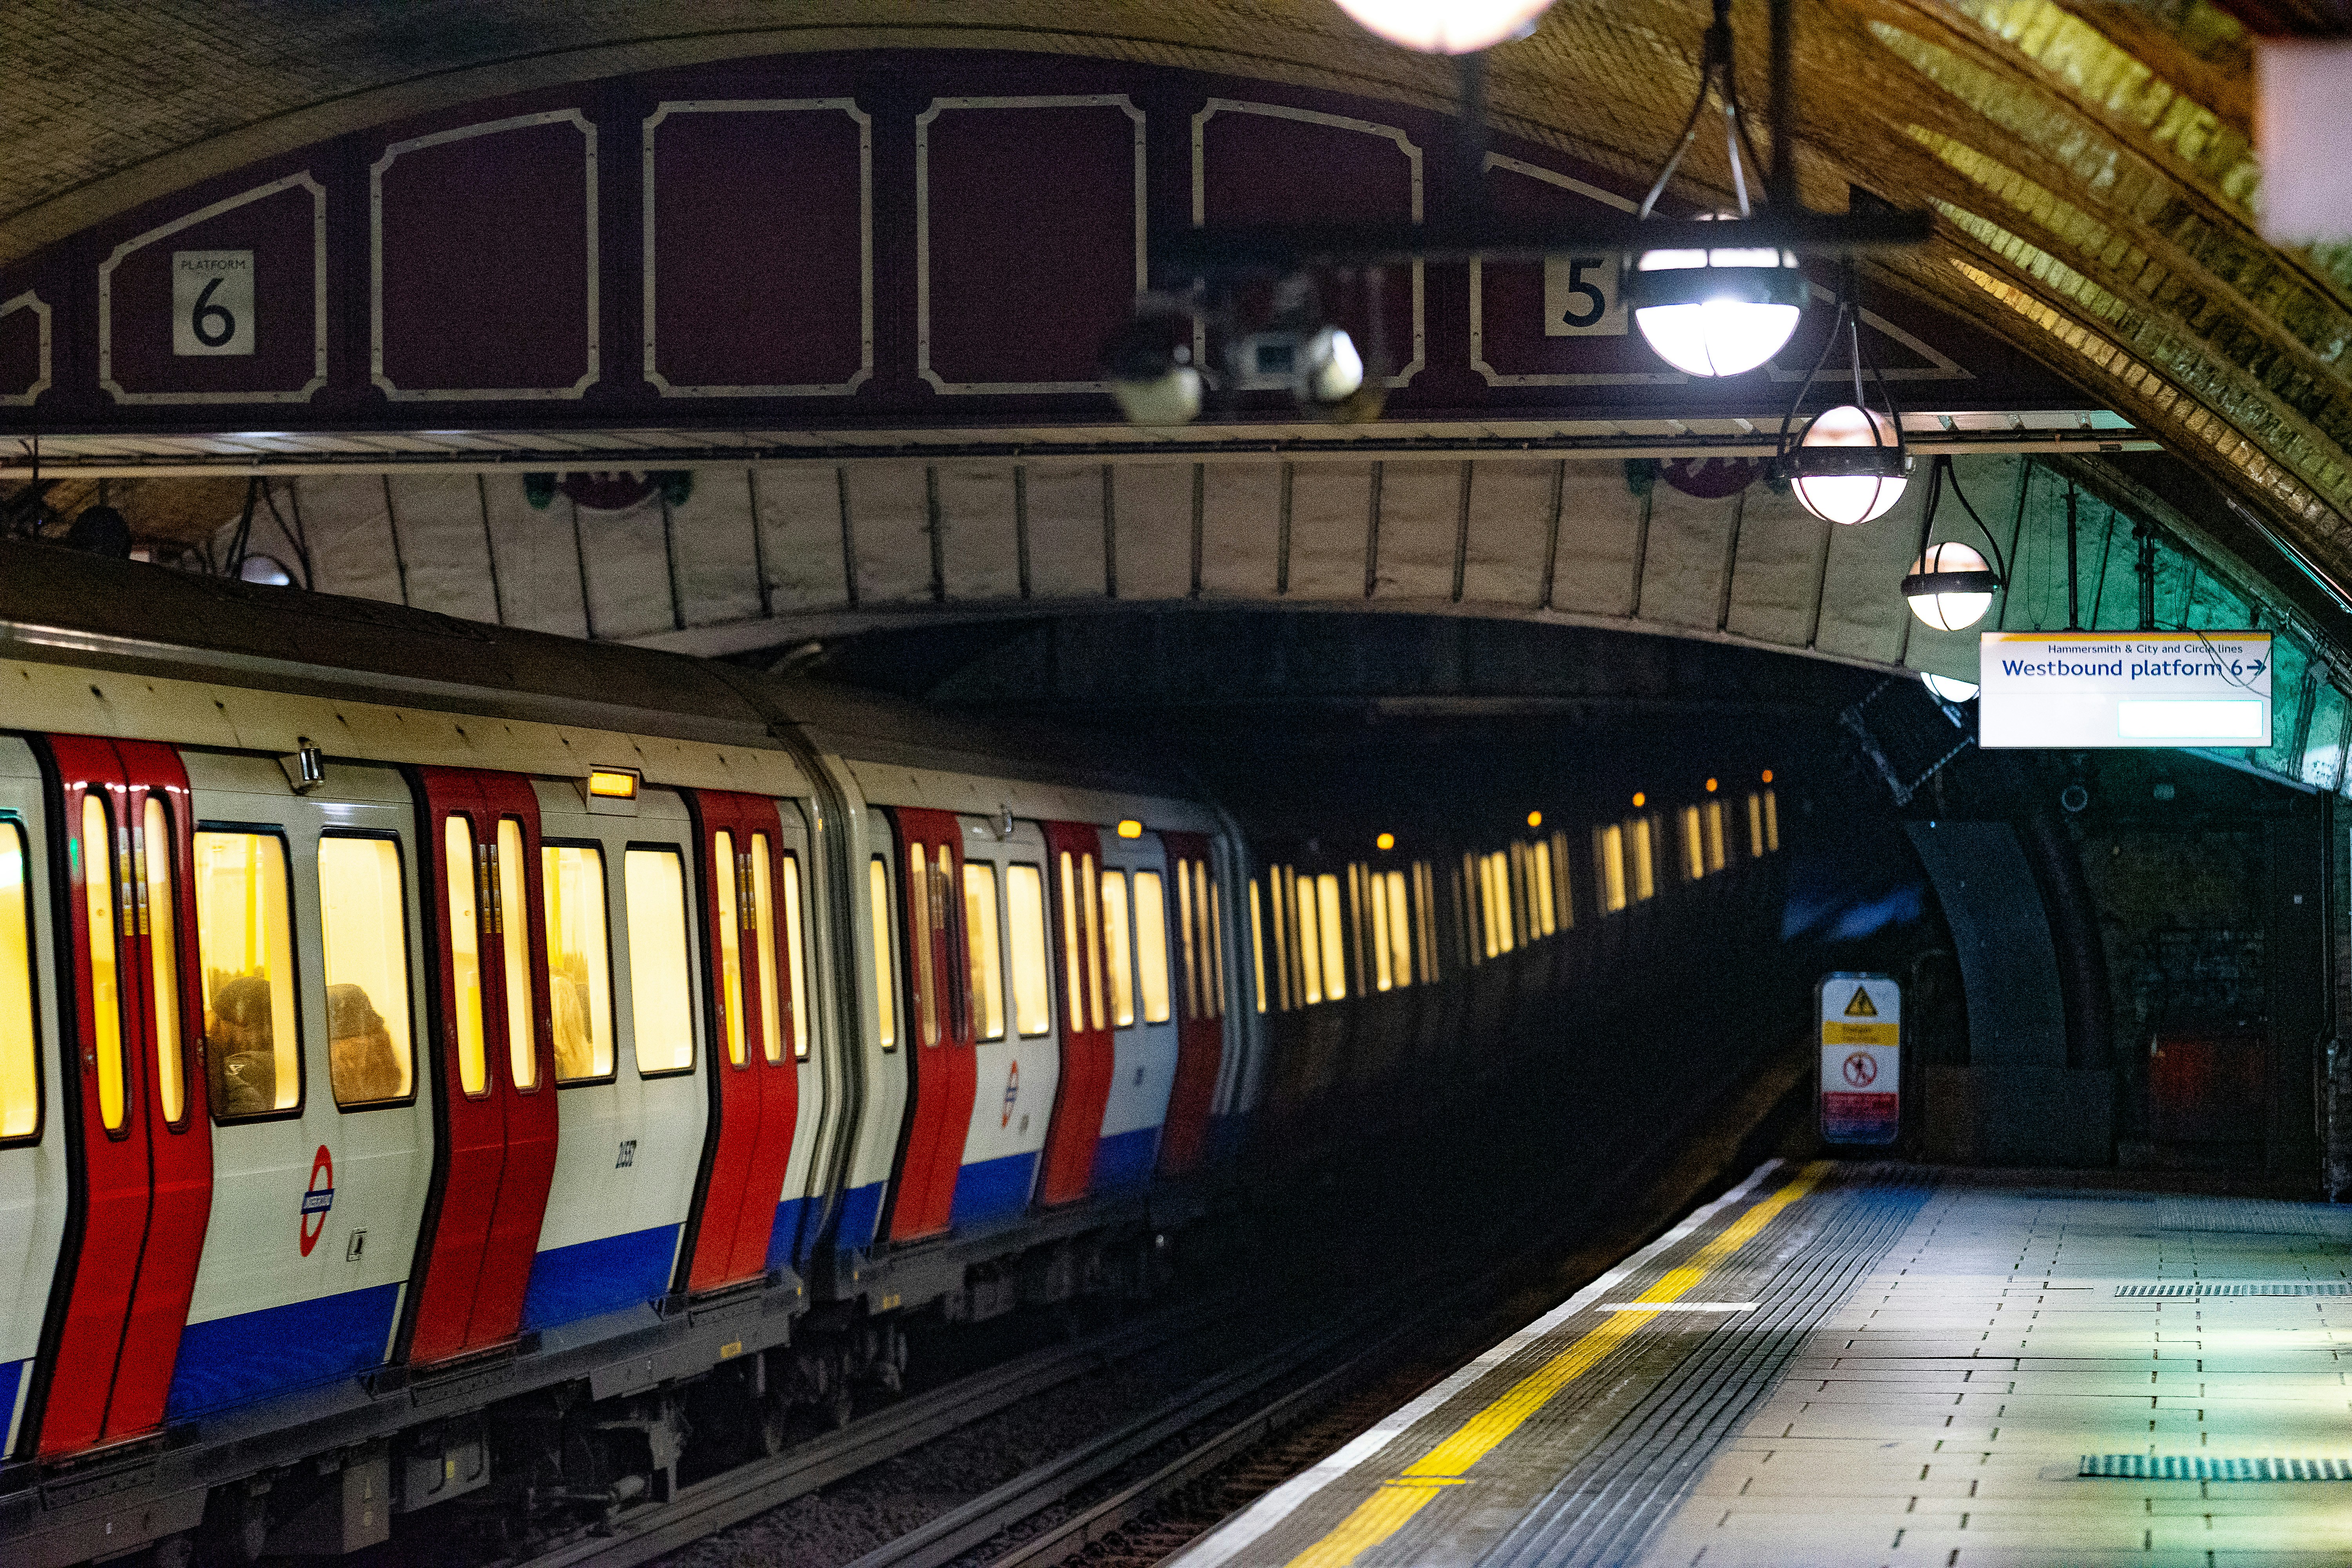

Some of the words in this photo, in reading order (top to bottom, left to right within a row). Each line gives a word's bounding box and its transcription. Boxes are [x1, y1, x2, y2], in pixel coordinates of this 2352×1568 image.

[181, 260, 246, 270] PLATFORM
[1563, 258, 1605, 327] 5
[193, 278, 235, 347] 6
[2048, 645, 2121, 653] Hammersmith
[2125, 645, 2132, 653] &
[2137, 644, 2158, 655] City
[2162, 644, 2180, 653] and
[2184, 644, 2216, 653] Circle
[2218, 644, 2243, 653] lines
[2002, 659, 2122, 676] Westbound
[2131, 659, 2222, 680] platform
[2231, 659, 2243, 676] 6
